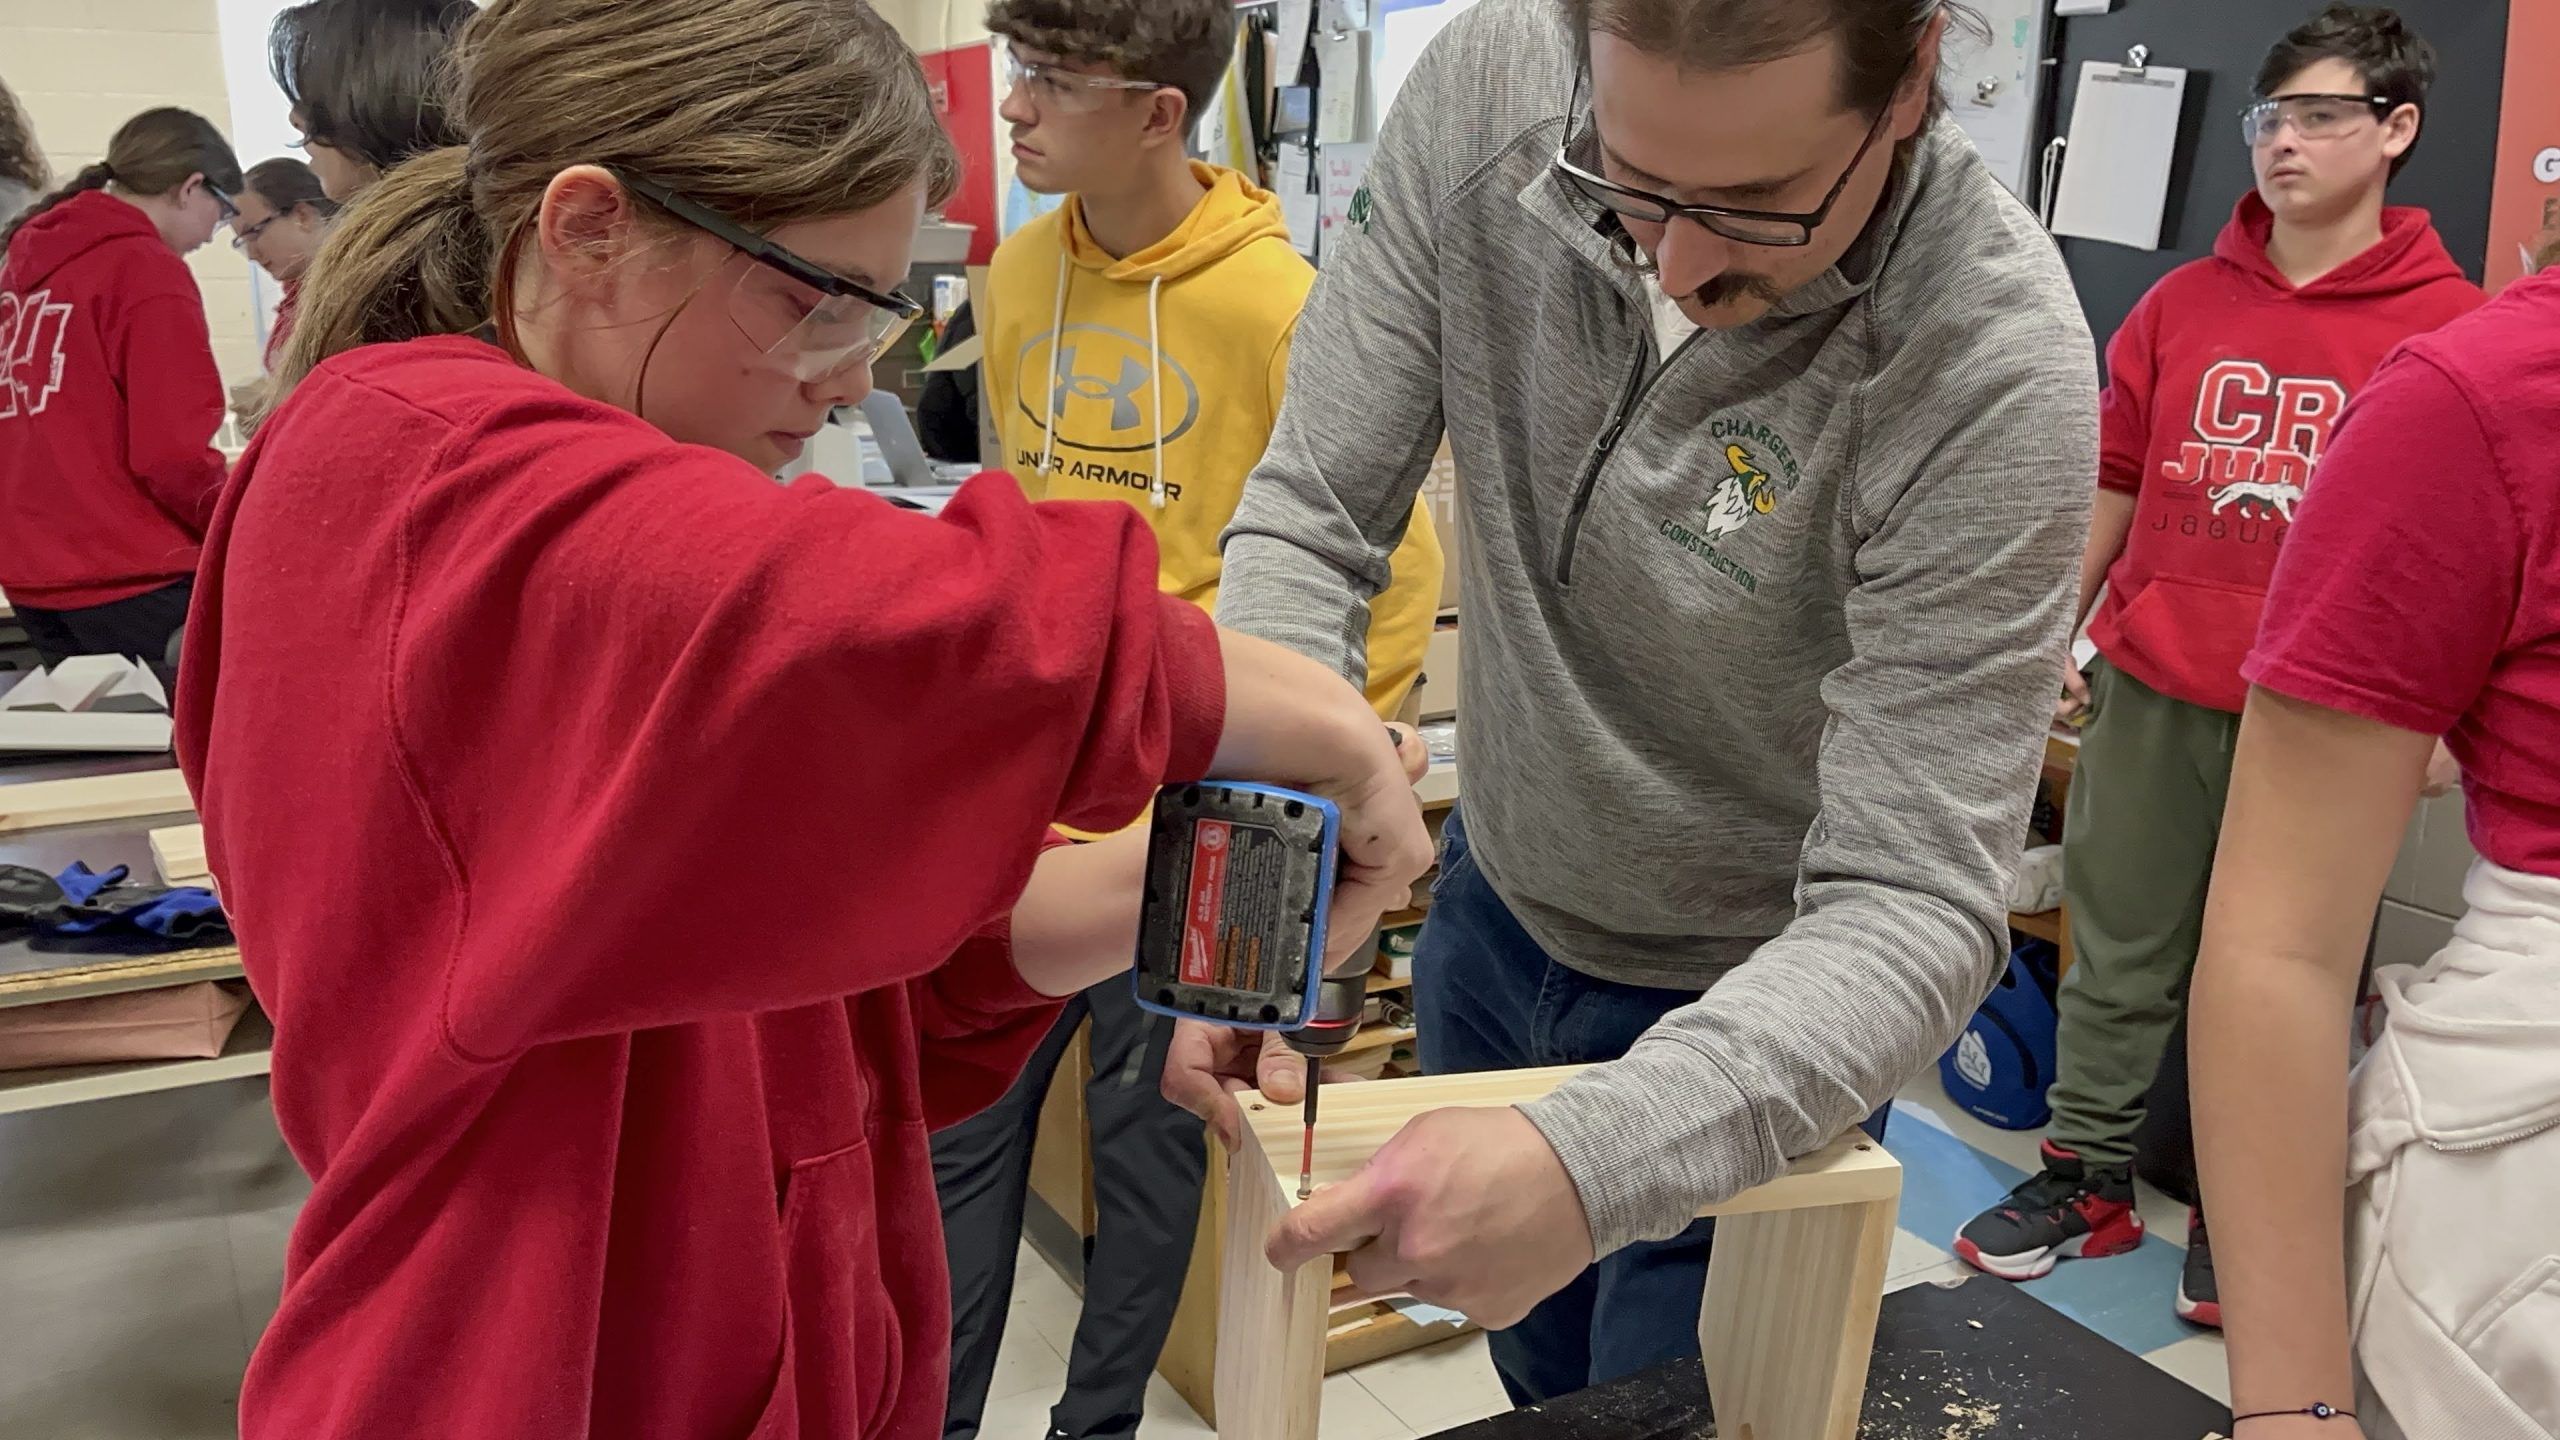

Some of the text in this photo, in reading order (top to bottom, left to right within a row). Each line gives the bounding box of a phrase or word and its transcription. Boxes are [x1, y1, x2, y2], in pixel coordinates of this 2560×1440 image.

[1016, 448, 1065, 475] UNR
[1711, 419, 1800, 489] CHARGERS
[1660, 519, 1758, 593] CONSTRUCTION
